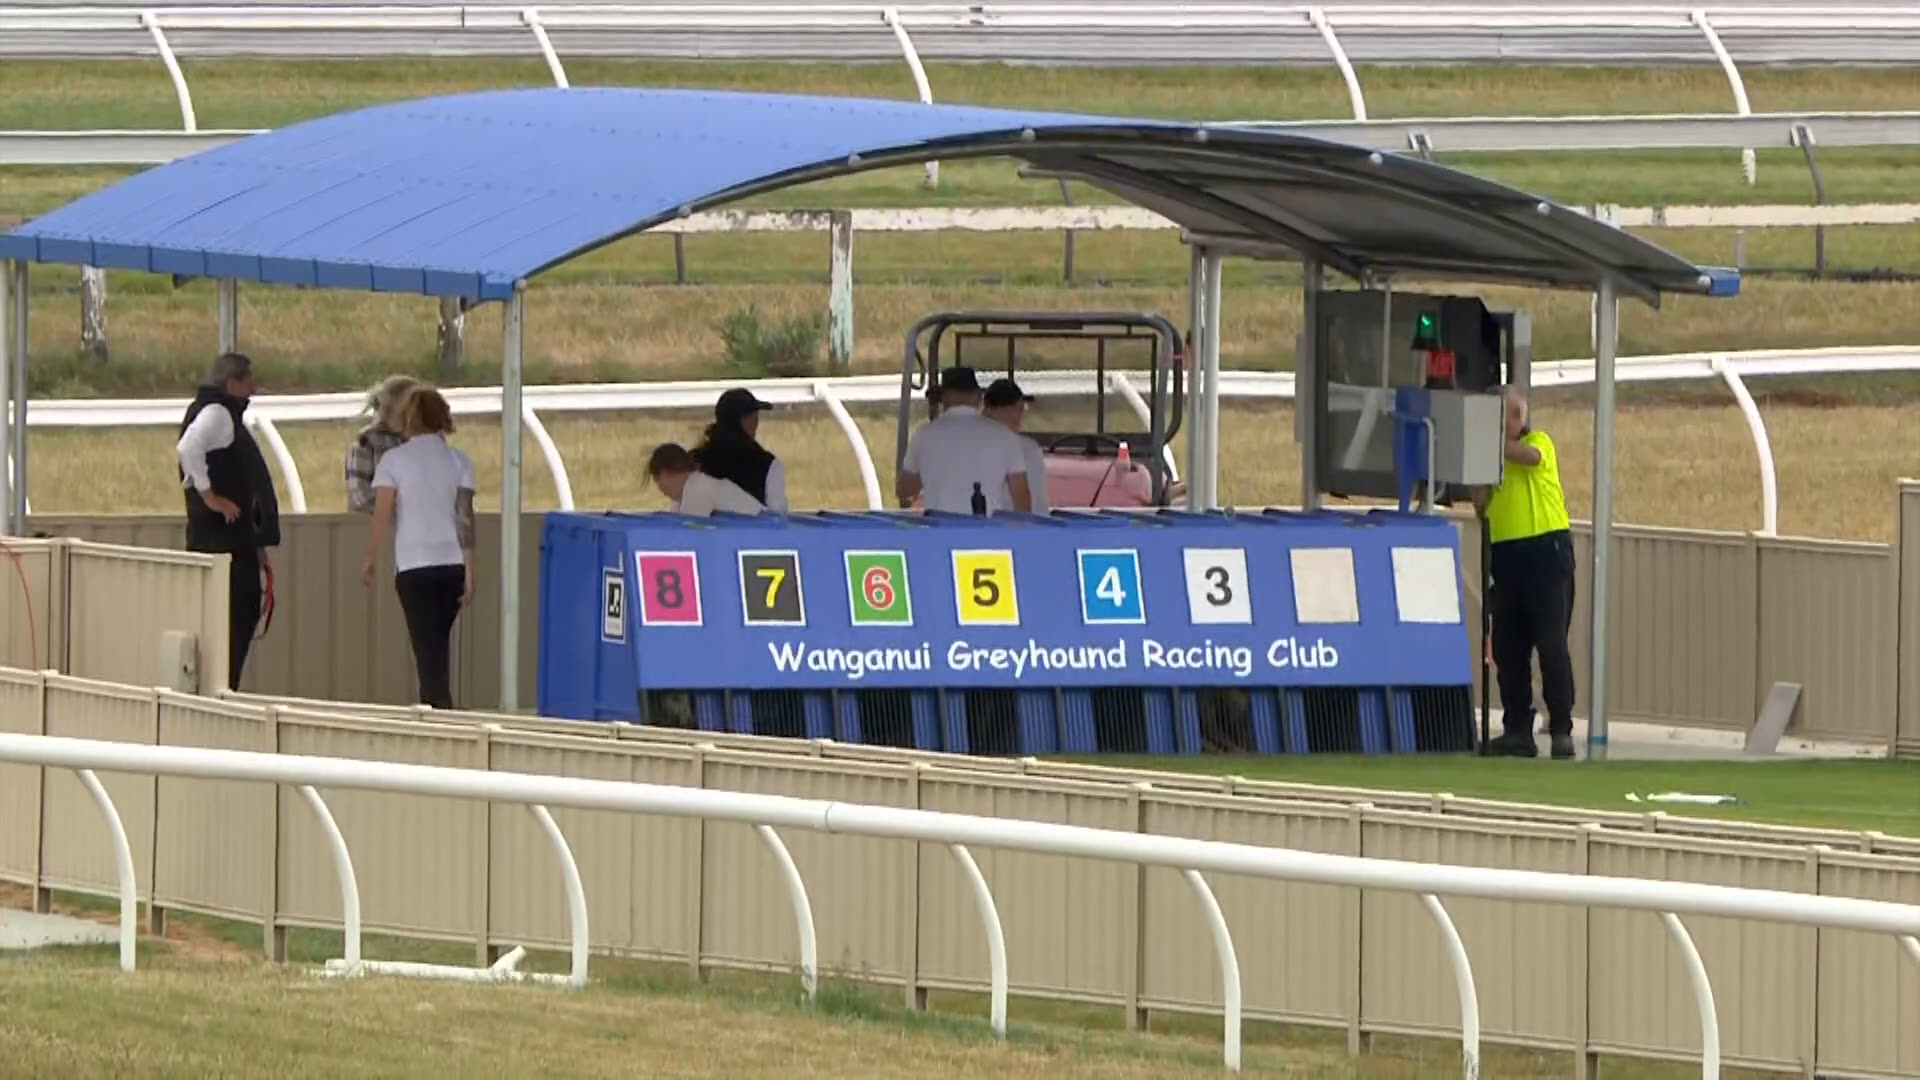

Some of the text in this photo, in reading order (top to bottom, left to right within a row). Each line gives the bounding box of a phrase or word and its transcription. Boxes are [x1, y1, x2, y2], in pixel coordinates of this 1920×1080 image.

[655, 566, 1233, 610] 8 7 6 5 4 3
[768, 638, 1338, 679] Wanganui Greyhound Racing Club
